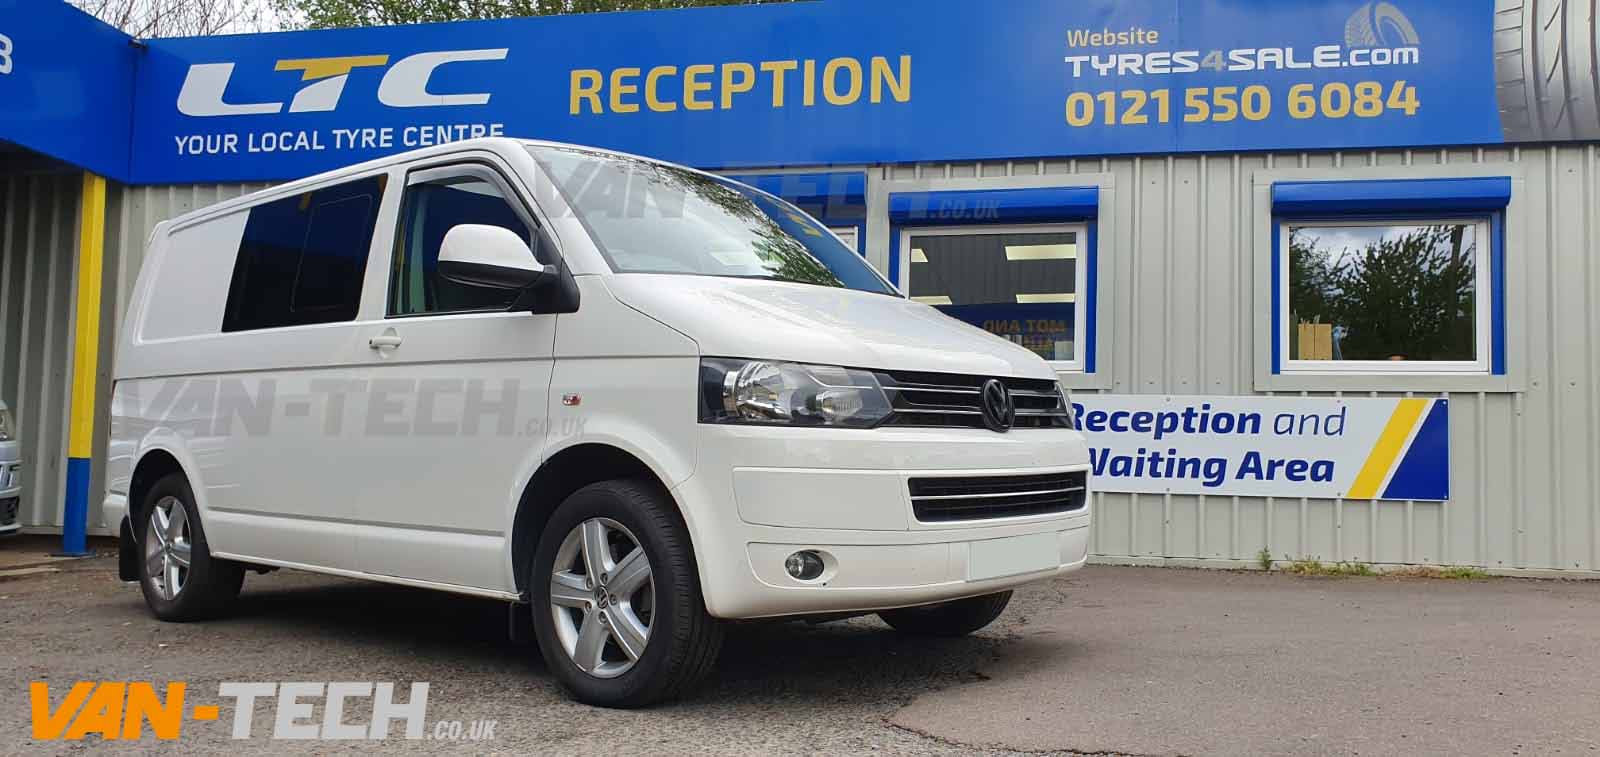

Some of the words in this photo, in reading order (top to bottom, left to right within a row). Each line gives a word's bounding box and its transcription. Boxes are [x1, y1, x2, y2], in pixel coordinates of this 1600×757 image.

[1067, 27, 1159, 47] Website
[177, 48, 509, 117] LTC
[569, 55, 912, 115] RECEPTION
[1065, 89, 1170, 127] 0121
[1184, 86, 1272, 122] 550
[1287, 80, 1420, 120] 6084
[175, 134, 238, 156] YOUR
[248, 130, 326, 153] LOCAL
[332, 128, 394, 150] TYRE
[403, 123, 504, 147] CENTRE
[1272, 407, 1346, 436] and
[1236, 451, 1335, 483] Area
